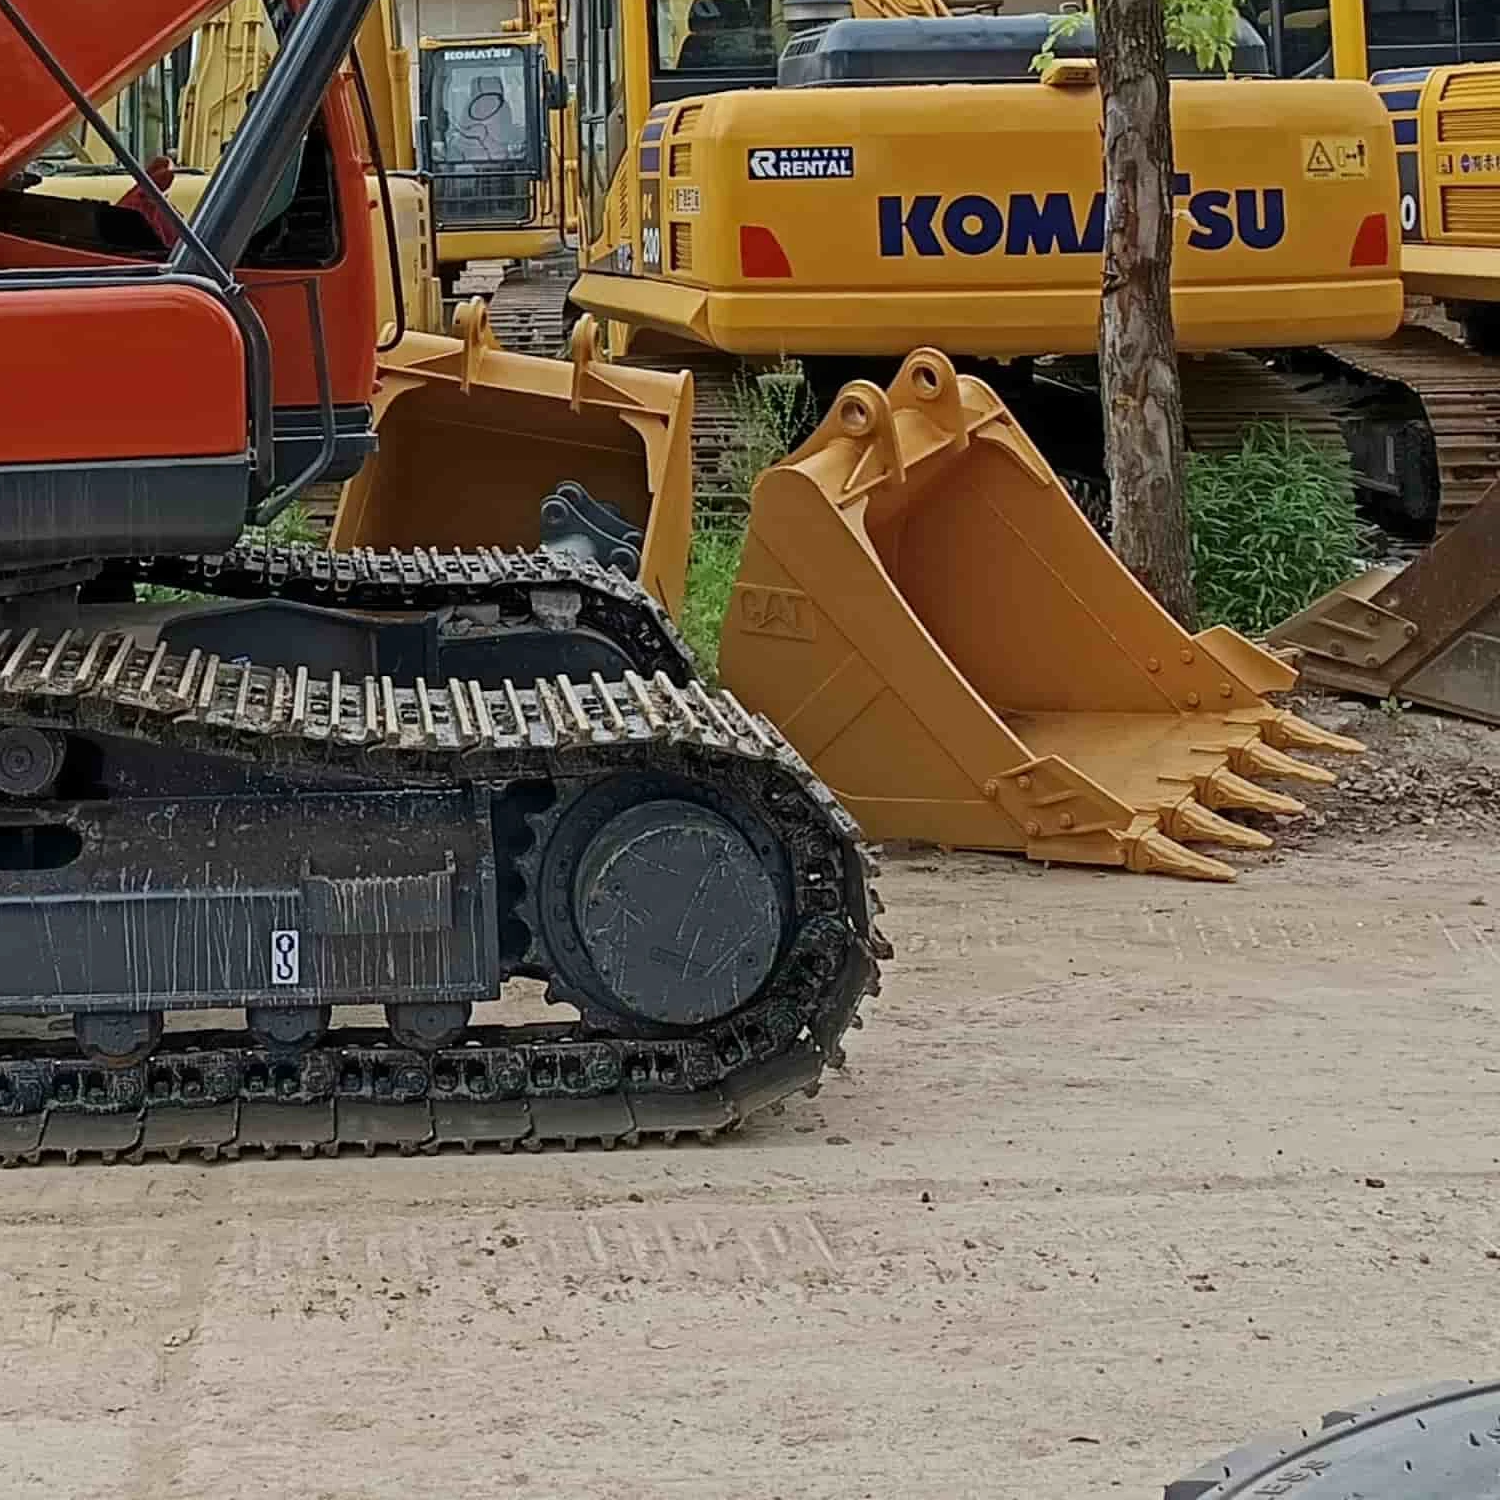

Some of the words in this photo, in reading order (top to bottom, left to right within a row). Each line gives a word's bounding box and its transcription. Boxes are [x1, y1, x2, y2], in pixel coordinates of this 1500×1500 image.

[444, 47, 512, 61] KOMATSU
[780, 148, 850, 159] KOMATSU
[780, 160, 853, 177] RENTAL
